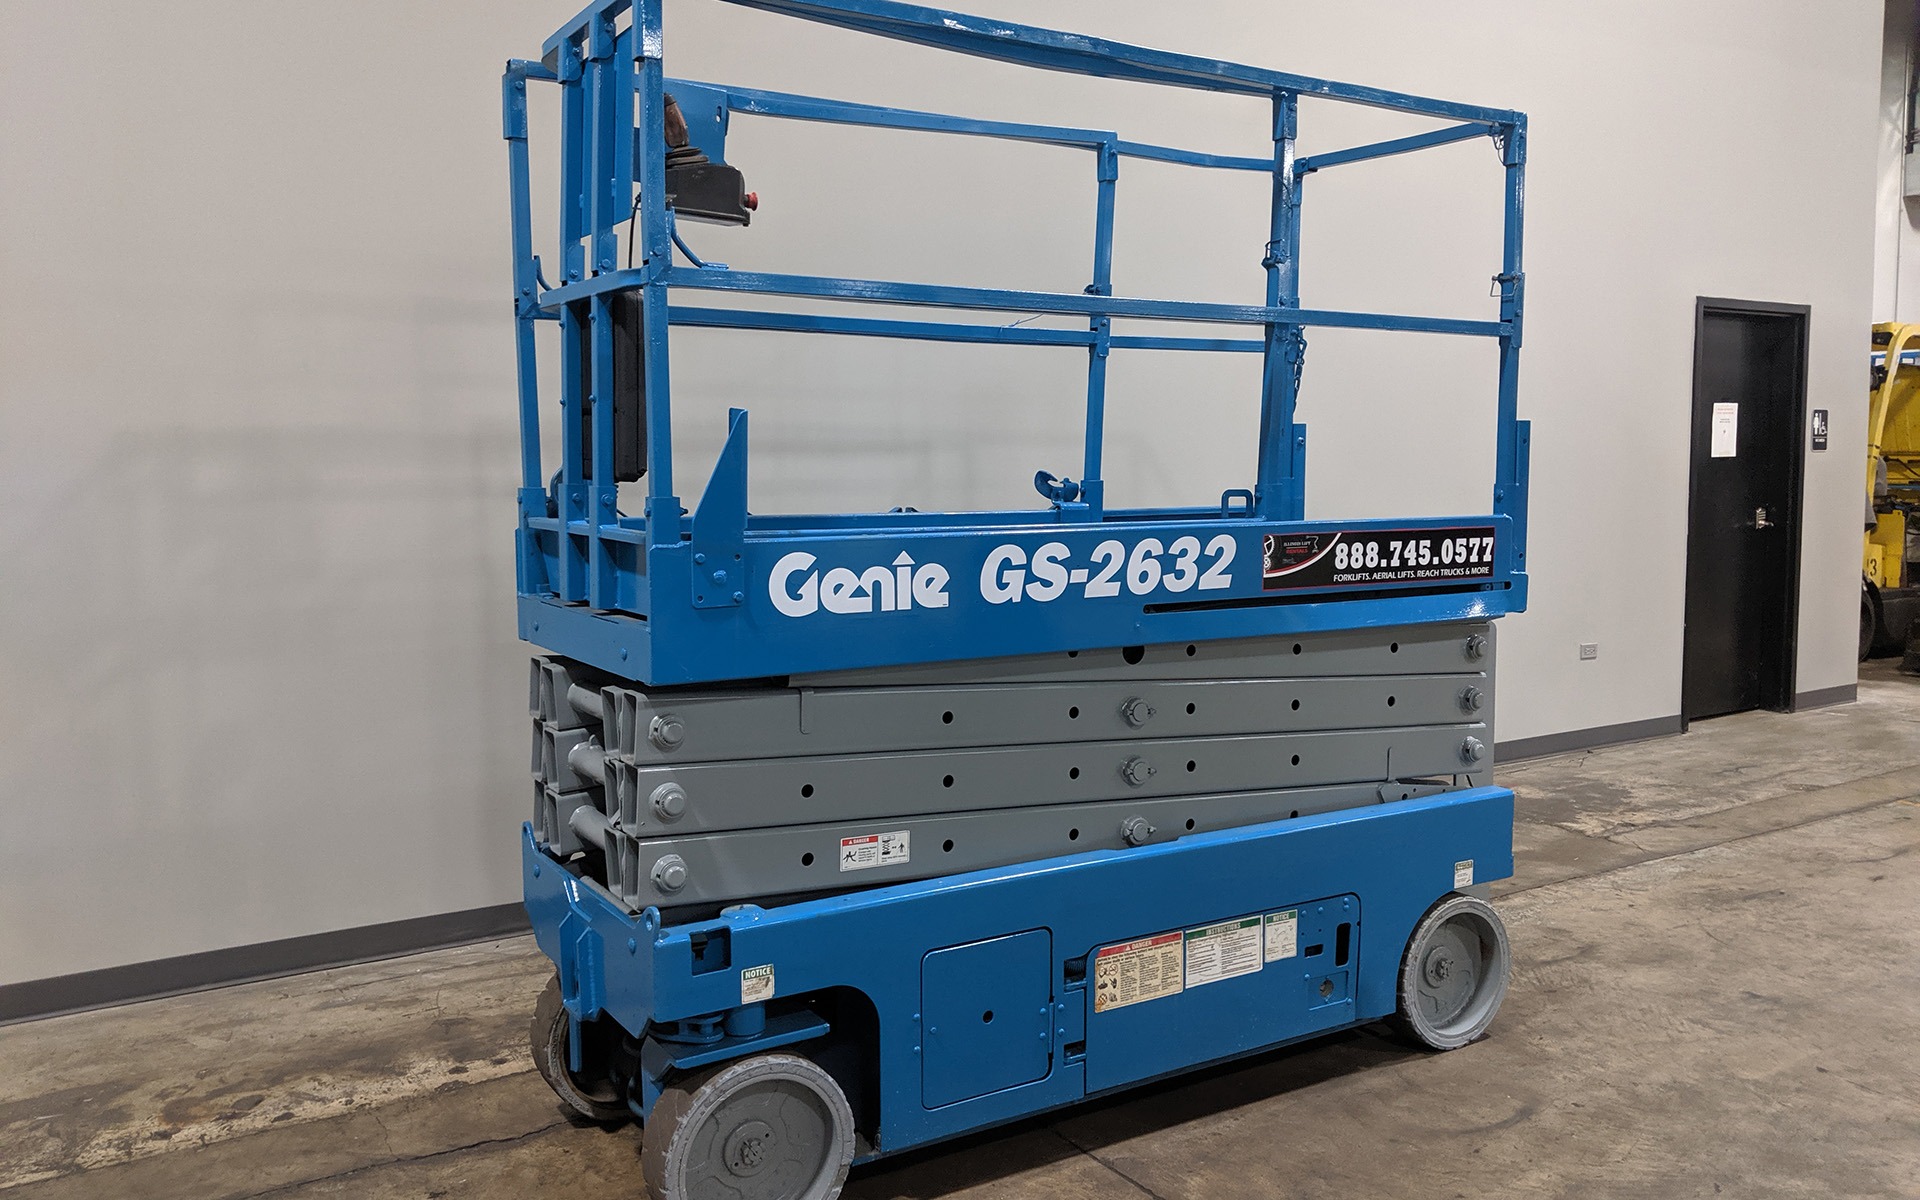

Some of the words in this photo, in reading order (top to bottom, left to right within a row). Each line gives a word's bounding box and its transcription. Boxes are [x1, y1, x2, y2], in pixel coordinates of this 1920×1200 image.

[1334, 537, 1494, 570] 888.745.0577
[768, 550, 950, 618] Genie
[979, 534, 1237, 604] GS-2632
[1372, 572, 1396, 580] AERIAL
[1416, 570, 1440, 578] REACH
[1440, 568, 1464, 576] TRUCKS
[1470, 566, 1490, 574] MORE
[1272, 912, 1290, 922] NOTICE
[1205, 922, 1241, 936] INSTRUCTIONS
[1131, 940, 1153, 950] DANGER
[745, 967, 771, 979] NOTICE
